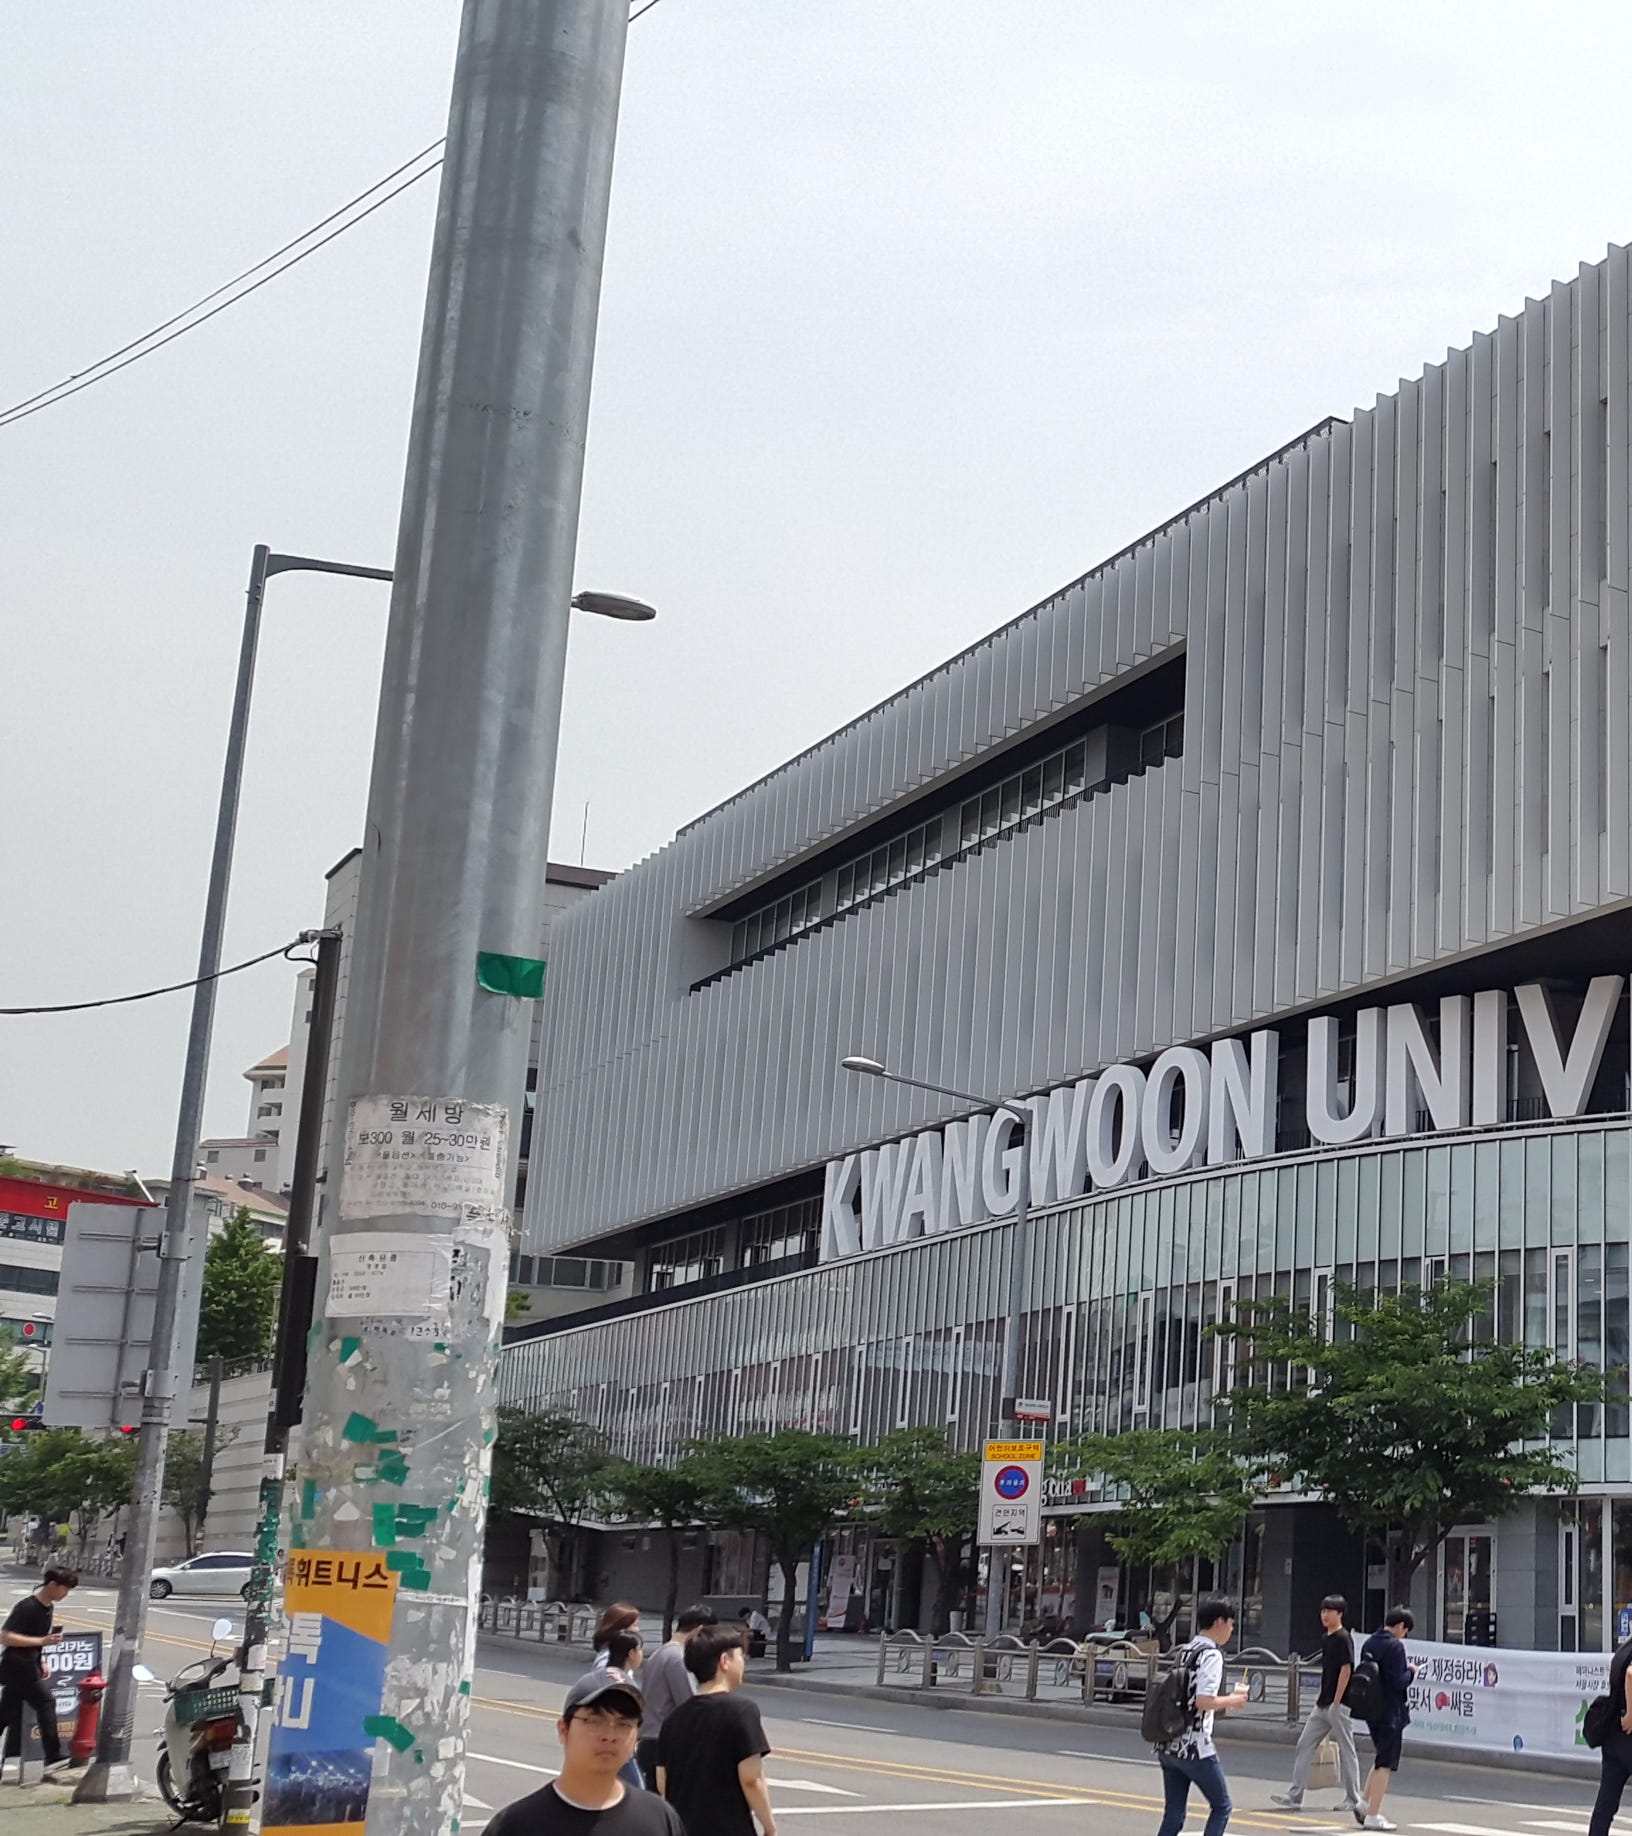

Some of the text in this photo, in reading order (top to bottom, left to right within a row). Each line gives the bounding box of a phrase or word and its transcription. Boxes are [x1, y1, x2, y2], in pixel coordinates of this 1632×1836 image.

[401, 1130, 416, 1146] 월
[819, 1029, 1279, 1263] KWANGWOON
[987, 1444, 1040, 1452] 어린이보호구역
[1431, 1658, 1482, 1686] 제정하라!
